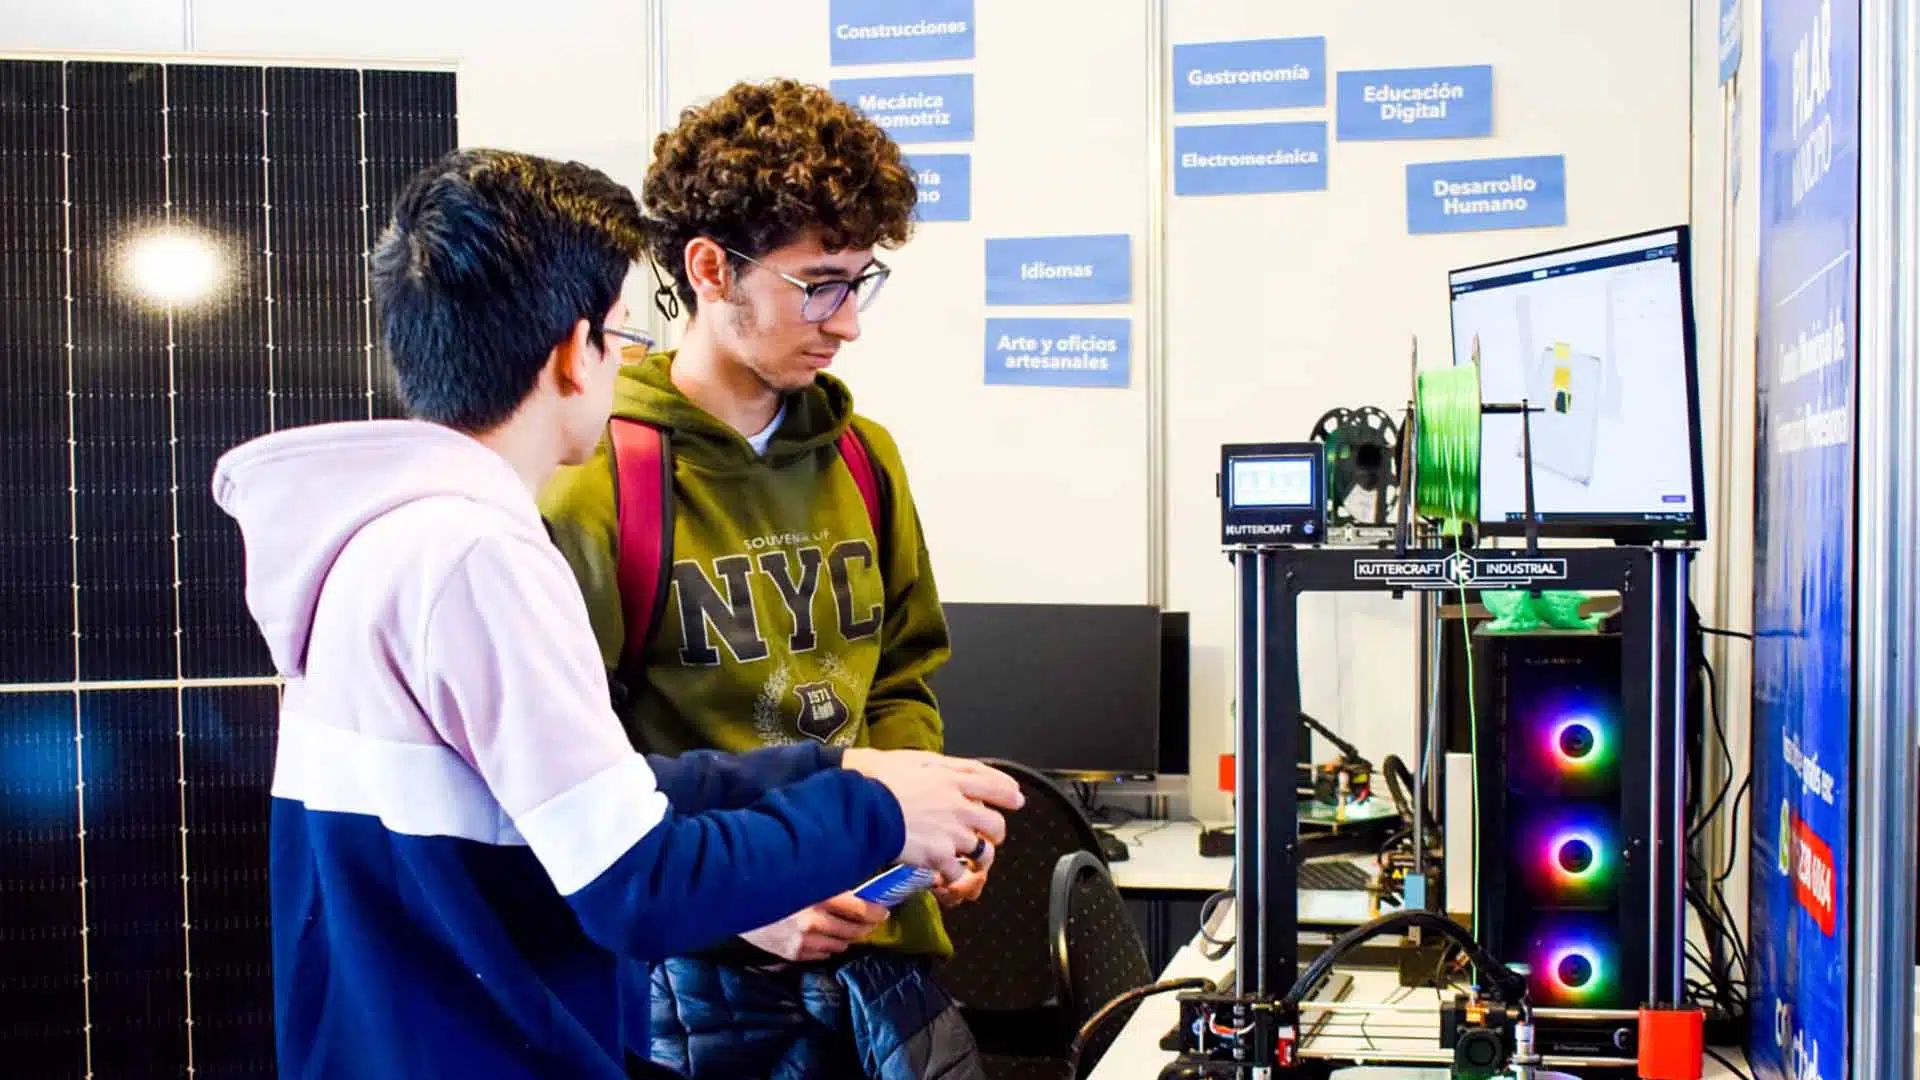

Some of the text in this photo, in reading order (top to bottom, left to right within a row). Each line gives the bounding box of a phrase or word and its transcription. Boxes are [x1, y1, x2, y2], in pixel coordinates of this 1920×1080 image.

[836, 20, 967, 40] Construcciones
[1188, 64, 1310, 86] Gastronomía
[859, 91, 944, 111] Mecánica
[1363, 83, 1463, 104] Educación
[866, 110, 951, 128] tomotriz
[1381, 101, 1447, 123] Digital
[1182, 149, 1318, 168] Electromecánica
[1433, 175, 1537, 198] Desarrollo
[1443, 196, 1528, 215] Humano
[1021, 263, 1093, 280] Idiomas
[997, 335, 1117, 357] Arte y oficios
[1005, 354, 1109, 371] artesanales
[1225, 523, 1293, 536] KUTTERCRAFT
[743, 531, 810, 550] SOUVEN
[1358, 563, 1442, 575] KUTTERCRAFT
[1485, 562, 1557, 575] INDUSTRIAL
[672, 538, 883, 667] NYC
